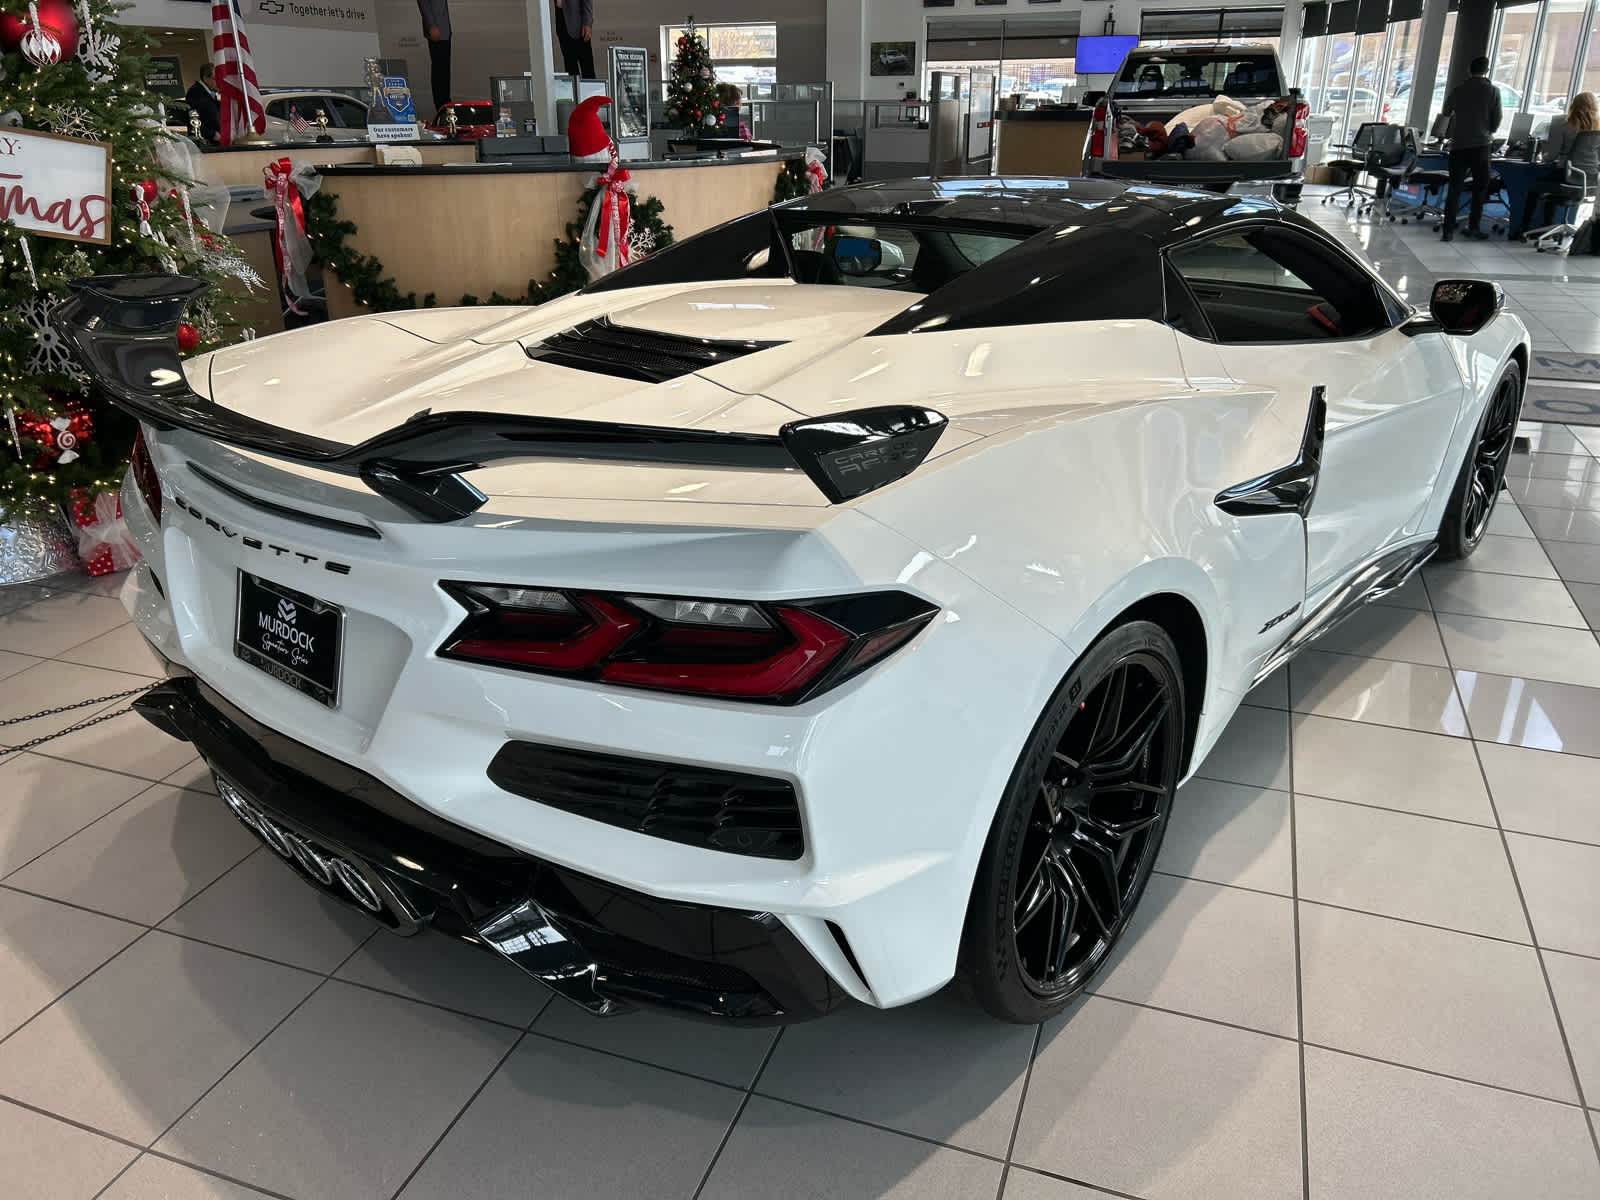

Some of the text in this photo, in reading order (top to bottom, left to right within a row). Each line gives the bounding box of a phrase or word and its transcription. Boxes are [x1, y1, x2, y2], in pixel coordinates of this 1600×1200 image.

[288, 2, 327, 17] Together
[346, 8, 366, 20] drive
[0, 173, 110, 239] mas
[175, 496, 352, 575] CORVETTE
[258, 610, 316, 653] MURDOCK
[291, 646, 310, 666] Series
